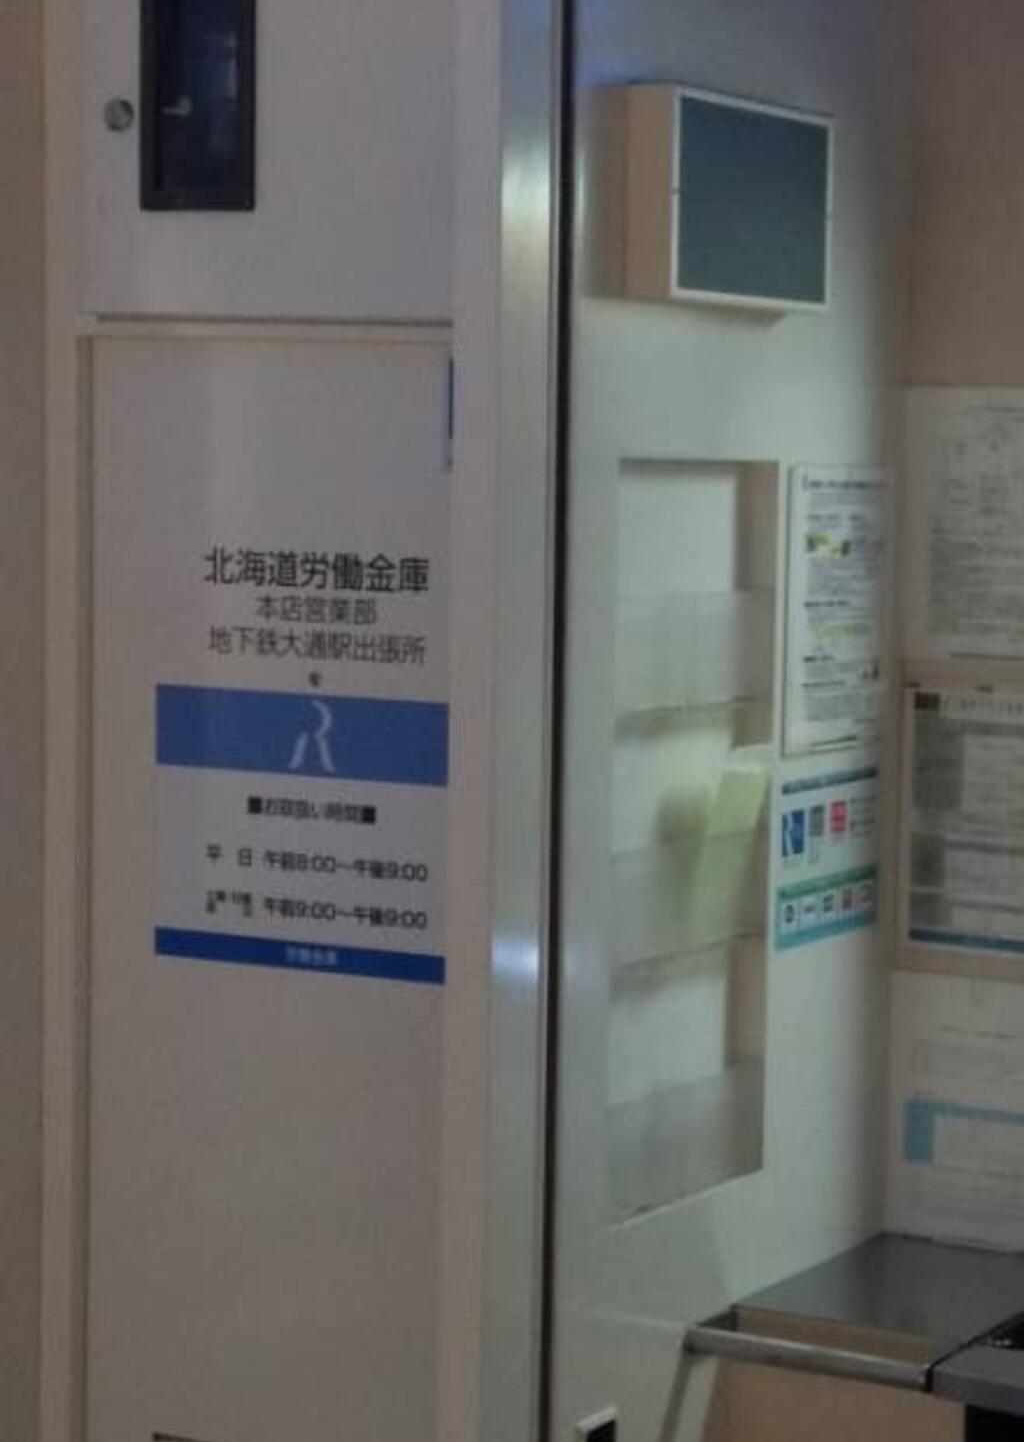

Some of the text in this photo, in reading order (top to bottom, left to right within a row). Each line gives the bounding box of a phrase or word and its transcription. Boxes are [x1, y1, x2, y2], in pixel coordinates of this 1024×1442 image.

[203, 546, 430, 594] 北海道労働金庫
[256, 596, 379, 626] 本店営業部
[208, 626, 427, 665] 地下鉄大通駅出張所
